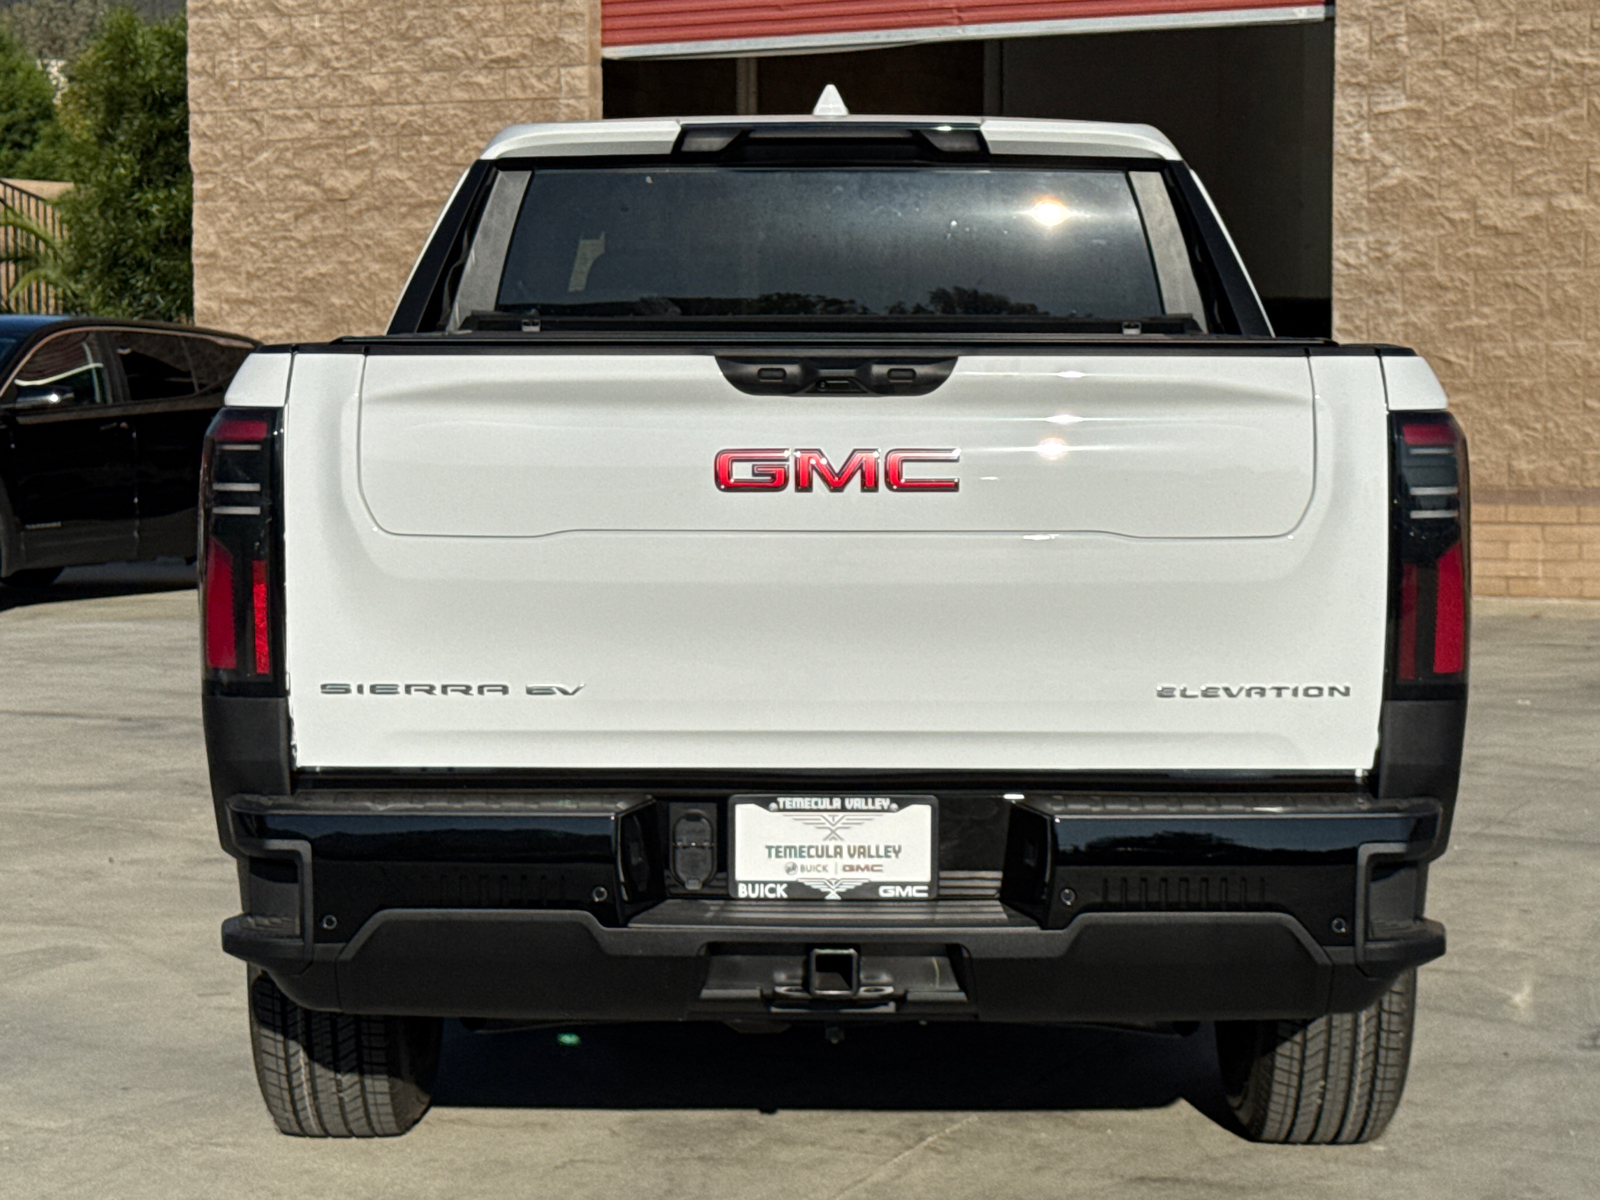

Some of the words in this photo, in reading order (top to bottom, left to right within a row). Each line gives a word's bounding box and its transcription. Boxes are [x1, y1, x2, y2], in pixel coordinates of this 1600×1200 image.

[714, 448, 961, 493] GMC
[320, 683, 509, 696] SIERRA
[525, 683, 586, 696] EV
[1156, 685, 1351, 698] ELEVATION
[777, 797, 842, 810] TEMECULA
[845, 797, 890, 810] VALLEY
[765, 845, 844, 859] TEMECULA
[847, 845, 902, 859] VALLEY
[800, 864, 829, 873] BUICK
[842, 864, 884, 873] GMC
[738, 883, 788, 898] BUICK
[879, 885, 929, 897] GMC
